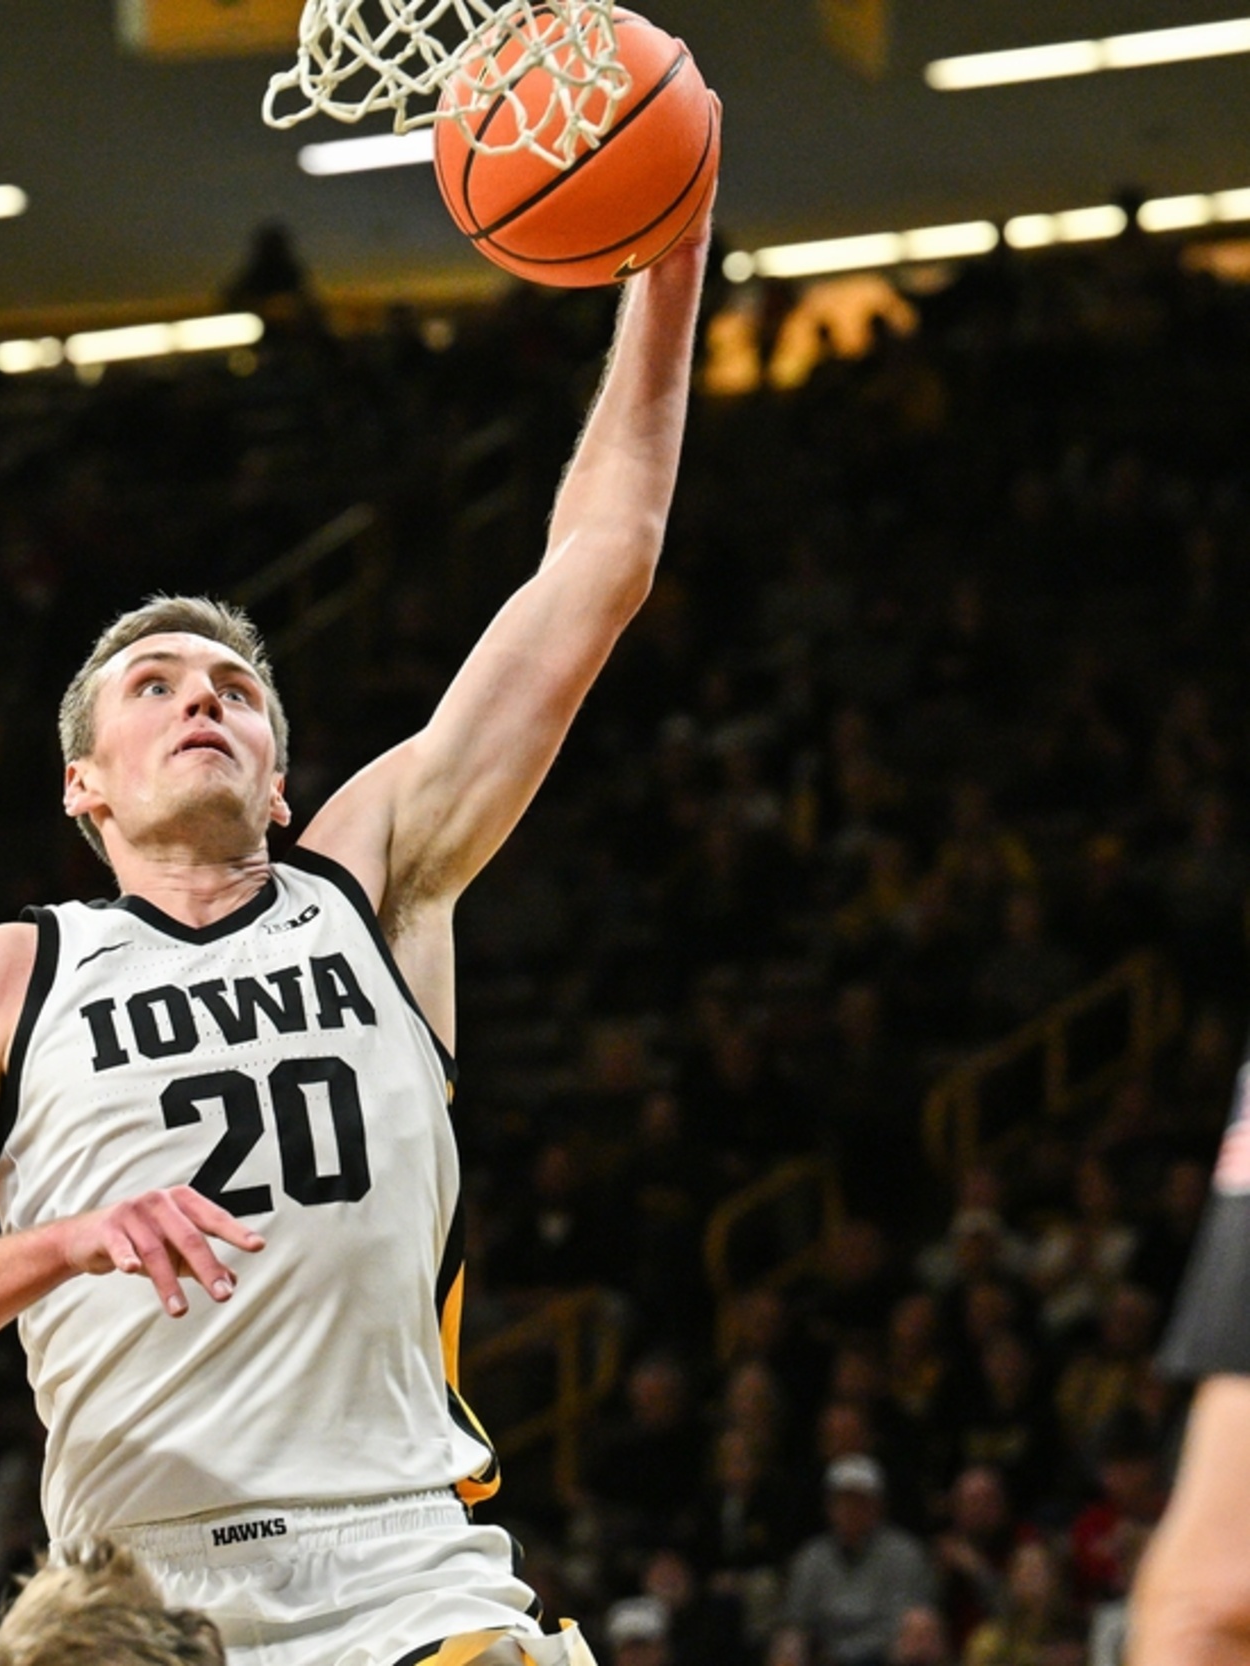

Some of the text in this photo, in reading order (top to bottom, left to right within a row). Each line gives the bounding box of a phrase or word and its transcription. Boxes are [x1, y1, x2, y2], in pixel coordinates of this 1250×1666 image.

[79, 951, 376, 1072] IOWA
[159, 1056, 371, 1217] 20
[211, 1517, 287, 1546] HAWKS
